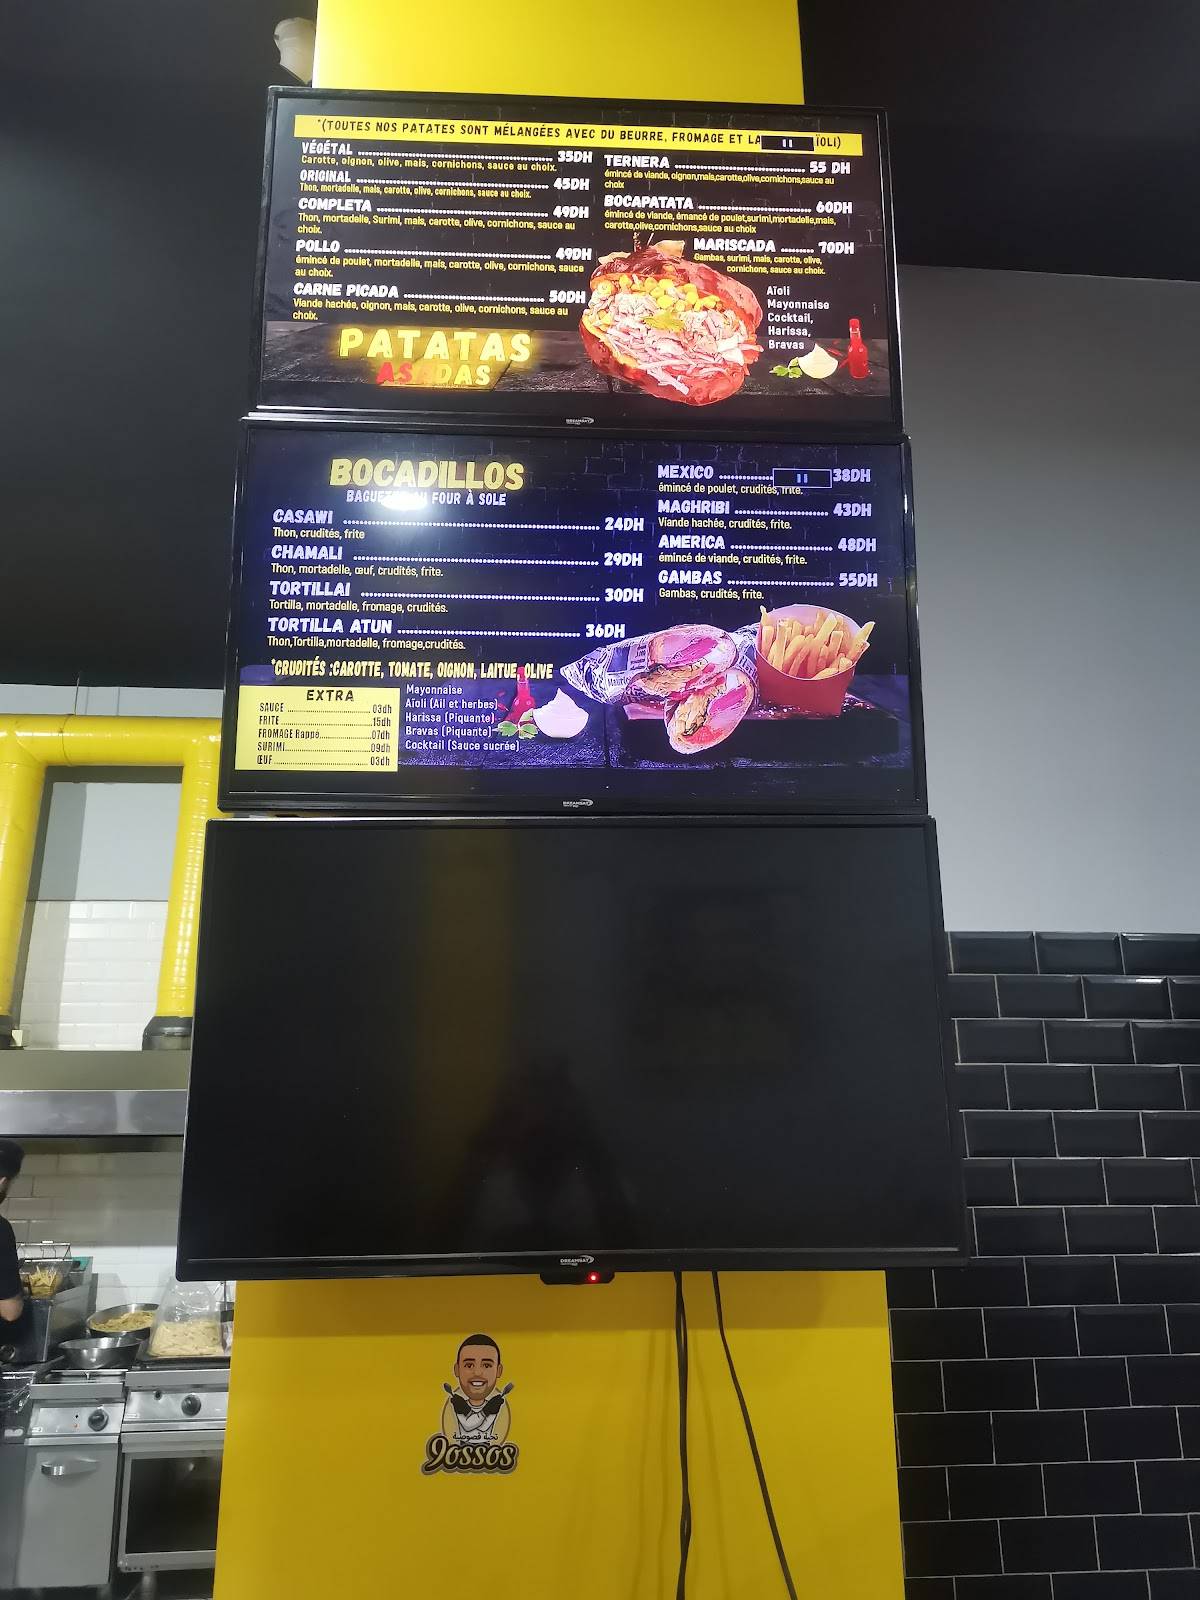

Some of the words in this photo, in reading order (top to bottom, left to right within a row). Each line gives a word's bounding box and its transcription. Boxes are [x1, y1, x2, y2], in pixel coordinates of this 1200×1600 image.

[376, 122, 397, 132] NOS
[402, 122, 455, 134] PATATES
[460, 124, 489, 135] SONT
[494, 124, 560, 138] MÉLANGÉES
[565, 128, 596, 139] AVEC
[601, 129, 615, 140] DU
[620, 130, 667, 142] BEURRE,
[672, 132, 724, 143] FROMAGE
[729, 134, 743, 144] ET
[302, 140, 353, 155] VÉGÉTAL
[558, 151, 592, 163] 35DH
[604, 154, 670, 169] TERNERA
[831, 162, 850, 174] DH
[300, 169, 351, 183] ORIGINAL
[553, 178, 589, 190] 45DH
[298, 198, 372, 212] COMPLETA
[553, 206, 589, 218] 49DH
[604, 194, 694, 210] BOCAPATATA
[816, 201, 852, 214] 60DH
[296, 239, 340, 253] POLLO
[555, 247, 592, 260] 49DH
[694, 238, 776, 252] MARISCADA
[818, 241, 854, 254] 70DH
[293, 282, 342, 296] CARNE
[346, 284, 399, 298] PICADA
[549, 290, 585, 303] 50DH
[766, 285, 790, 296] Aïoli
[767, 299, 830, 310] Mayonnaise
[768, 312, 813, 324] Cocktail,
[768, 325, 811, 337] Harissa,
[339, 328, 532, 362] PATATAS
[768, 339, 804, 350] Bravas
[329, 458, 525, 490] BOCADILLOS
[658, 465, 714, 479] MEXICO
[833, 468, 870, 482] 38DH
[658, 482, 692, 493] émincé
[694, 483, 706, 493] de
[707, 483, 738, 495] poulet,
[740, 484, 781, 496] crudités,
[346, 490, 408, 503] BAGUE
[432, 492, 460, 505] FOUR
[466, 489, 474, 505] À
[479, 493, 507, 506] SOLE
[658, 500, 729, 514] MAGHRIBI
[833, 503, 871, 516] 43DH
[273, 508, 333, 524] CASAWI
[604, 517, 644, 531] 24DH
[658, 516, 690, 527] Viande
[692, 517, 727, 530] hachée,
[728, 518, 768, 530] crudités,
[770, 519, 792, 529] frite.
[273, 526, 298, 539] Thon,
[300, 528, 342, 540] crudités,
[344, 528, 365, 539] frite
[658, 534, 725, 549] AMERICA
[838, 538, 876, 552] 48DH
[271, 544, 343, 560] CHAMALI
[604, 552, 642, 566] 29DH
[658, 552, 692, 562] émincé
[694, 552, 706, 563] de
[708, 552, 741, 565] viande,
[742, 554, 784, 566] crudités,
[784, 554, 808, 565] frite.
[271, 563, 296, 575] Thon,
[299, 564, 352, 576] mortadelle,
[354, 565, 375, 577] œuf,
[378, 565, 418, 578] crudités,
[421, 566, 444, 577] frite.
[658, 570, 722, 584] GAMBAS
[839, 573, 877, 587] 55DH
[270, 580, 350, 596] TORTILLAI
[604, 588, 644, 602] 30DH
[659, 588, 698, 600] Gambas,
[700, 588, 740, 600] crudités,
[742, 589, 764, 599] frite.
[269, 599, 304, 612] Tortilla,
[306, 600, 360, 612] mortadelle,
[362, 601, 405, 614] fromage,
[407, 602, 448, 613] crudités.
[268, 617, 344, 633] TORTILLA
[349, 618, 392, 634] ATUN
[586, 624, 625, 638] 36DH
[382, 637, 466, 651] fromage,crudités.
[329, 660, 384, 679] :CAROTTE,
[388, 661, 433, 680] TOMATE,
[437, 662, 477, 680] OIGNON,
[480, 662, 519, 681] LAITUE,
[523, 663, 553, 681] OLIVE
[306, 689, 353, 702] EXTRA
[406, 684, 462, 696] Mayonnaise
[259, 702, 284, 712] SAUCE
[372, 704, 392, 714] 03dh
[405, 698, 426, 708] Aïoli
[430, 698, 446, 709] (Ail
[448, 699, 461, 708] et
[460, 698, 500, 710] herbes)
[259, 715, 279, 725] FRITE
[373, 717, 391, 727] 15dh
[406, 712, 441, 722] Harissa
[445, 712, 497, 724] (Piquante)
[258, 728, 293, 739] FROMAGE
[372, 730, 390, 740] 07dh
[406, 726, 438, 738] Bravas
[442, 725, 494, 738] (Piquante)
[257, 742, 286, 752] SURIMI
[370, 742, 391, 753] 09dh
[405, 739, 444, 753] Cocktail
[448, 739, 480, 752] (Sauce
[483, 740, 522, 752] sucrée)
[257, 754, 272, 765] ŒUF
[370, 756, 390, 766] 03dh
